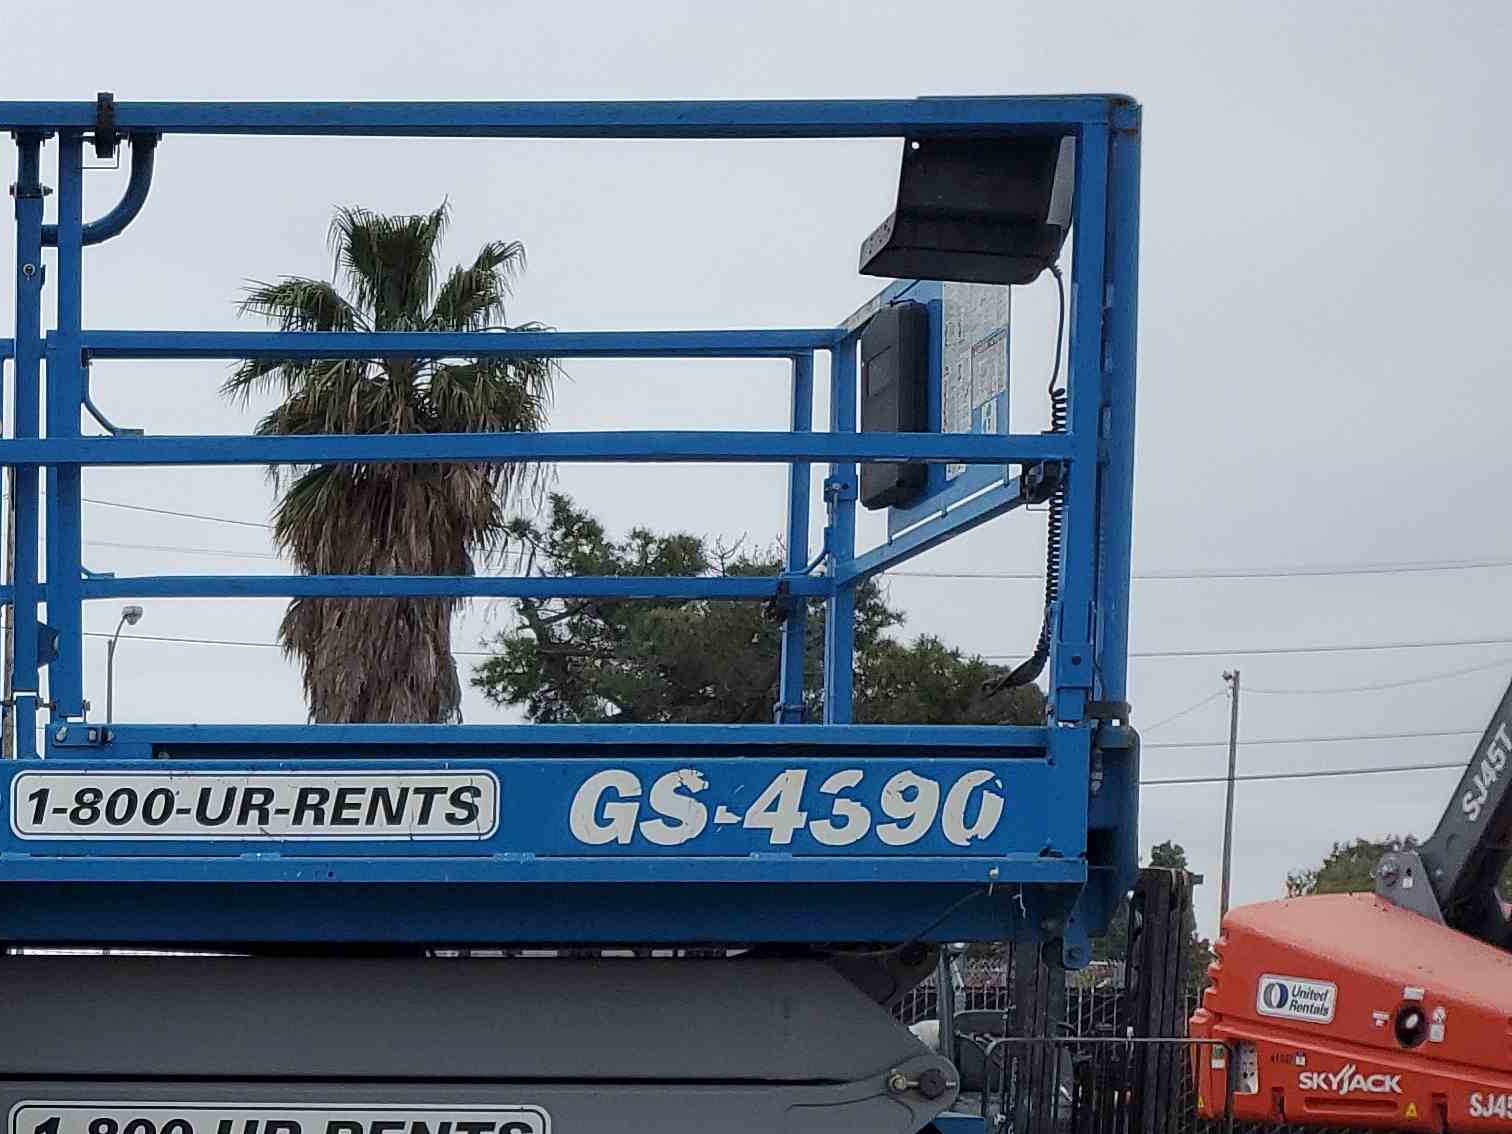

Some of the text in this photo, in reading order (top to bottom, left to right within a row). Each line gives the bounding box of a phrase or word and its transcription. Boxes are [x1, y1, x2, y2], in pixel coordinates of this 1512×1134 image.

[27, 785, 482, 826] 1-800-UR-RENTS
[569, 768, 1005, 846] GS-4390
[1288, 999, 1330, 1017] Rentals
[1291, 983, 1329, 1002] United
[1298, 1063, 1403, 1095] SKYJACK
